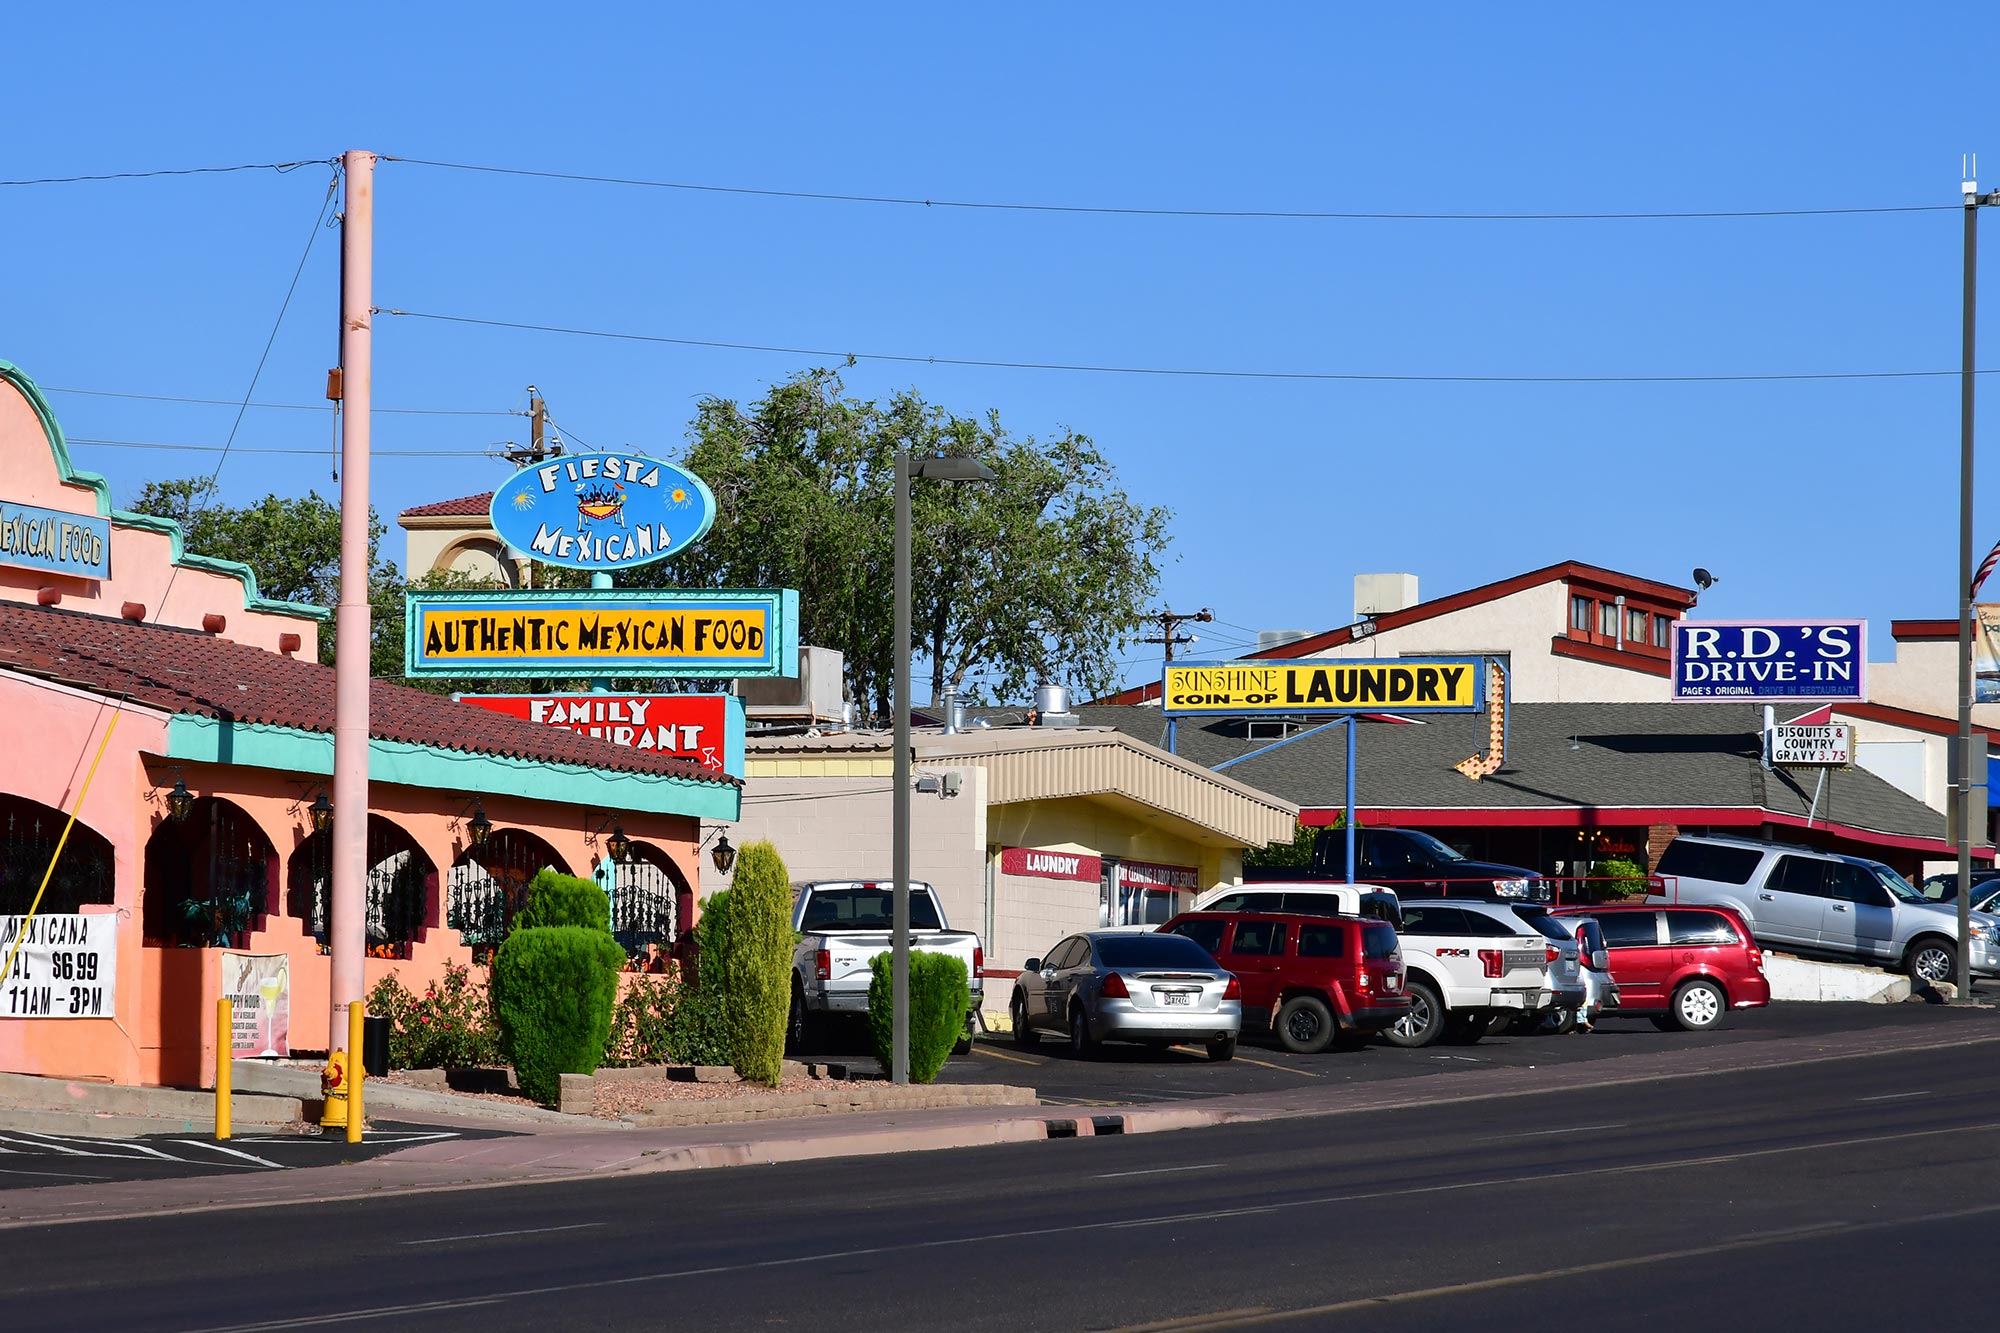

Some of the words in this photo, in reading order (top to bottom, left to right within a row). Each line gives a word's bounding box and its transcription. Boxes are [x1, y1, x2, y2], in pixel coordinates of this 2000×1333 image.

[538, 457, 659, 493] FIESTA
[0, 505, 57, 563] EXICAN
[60, 522, 102, 566] FOOD
[531, 522, 672, 563] MEXICANA
[425, 616, 569, 656] AUTHENTIC
[578, 614, 685, 654] MEXICAN
[695, 619, 763, 651] FOOD
[1685, 661, 1852, 682] DRIVE-IN
[1172, 669, 1278, 693] SUNSHINE
[1286, 667, 1465, 704] LAUNDRY
[1682, 686, 1711, 696] PAGE'S
[1715, 686, 1755, 696] ORIGINAL
[1758, 685, 1784, 695] DRIVE
[1787, 685, 1797, 695] IN
[1800, 685, 1855, 695] RESTAURANT
[1173, 693, 1278, 705] COIN-OP
[530, 700, 651, 725] FAMILY
[1777, 728, 1831, 738] BISQUITS
[1835, 728, 1843, 738] &
[1784, 739, 1835, 749] COUNTRY
[1776, 750, 1816, 761] GRAVY
[1819, 750, 1846, 761] 3.75
[1026, 853, 1080, 875] LAUNDRY
[1128, 866, 1153, 884] CLEANING
[1158, 869, 1171, 886] DROP
[1171, 871, 1180, 887] OFF
[1180, 872, 1198, 888] SERVICE
[52, 951, 99, 982] $6.99
[9, 986, 51, 1015] 11AM
[69, 986, 102, 1016] 3PM
[224, 994, 244, 1008] PPY
